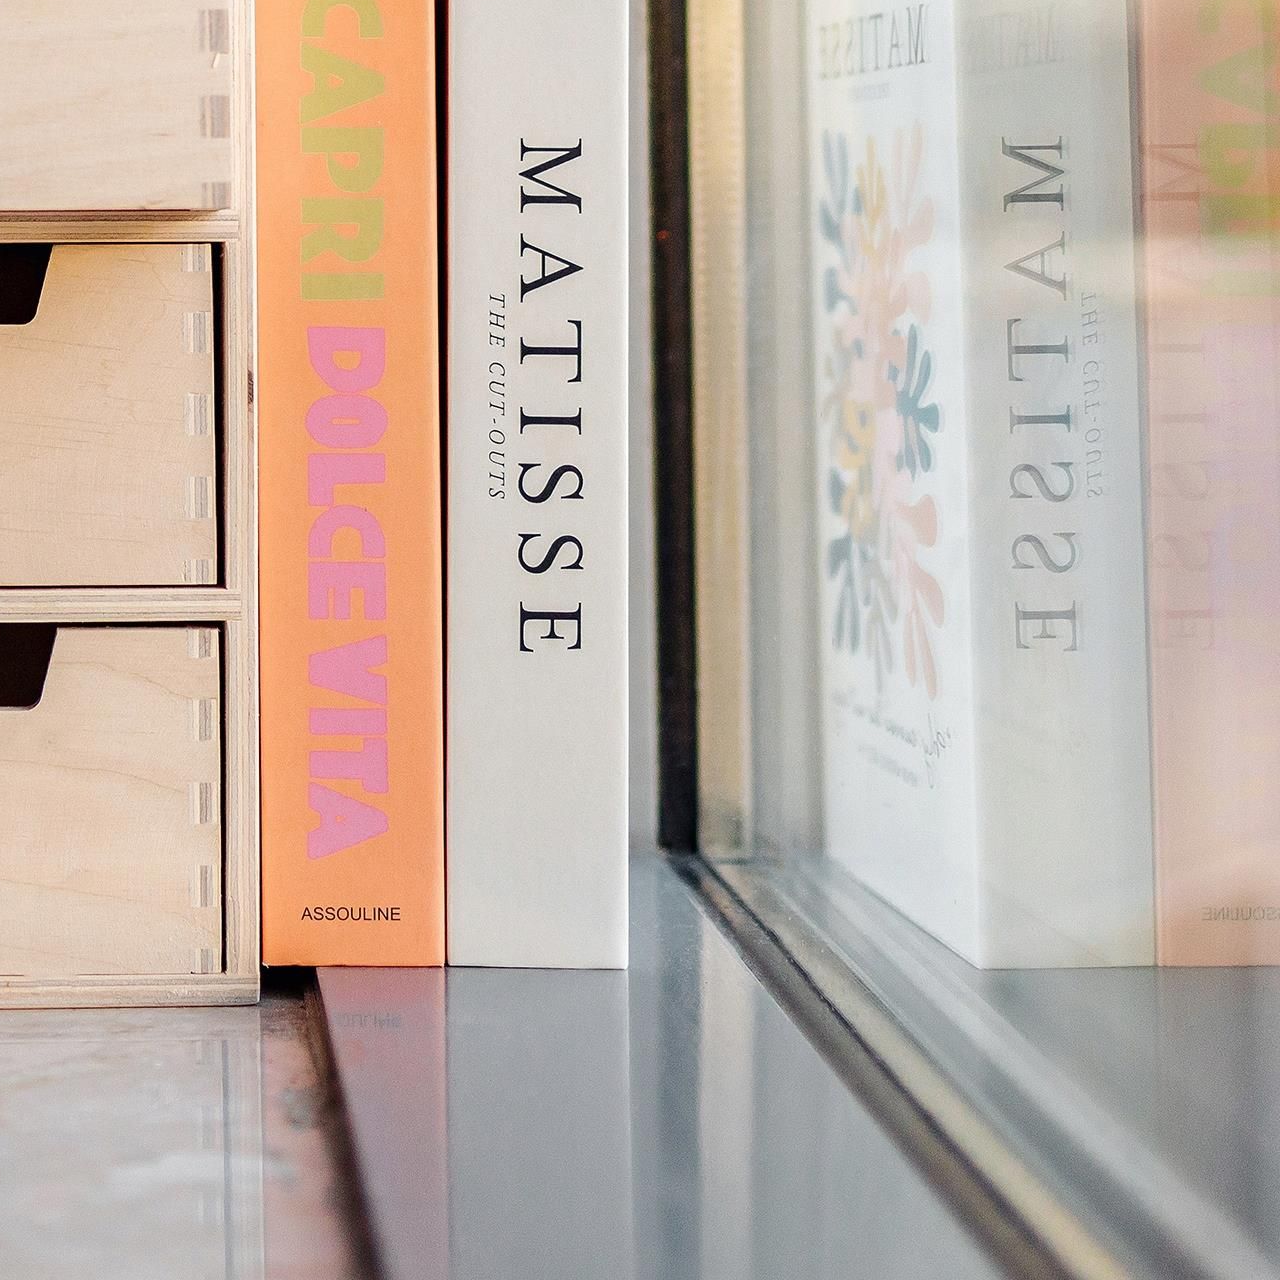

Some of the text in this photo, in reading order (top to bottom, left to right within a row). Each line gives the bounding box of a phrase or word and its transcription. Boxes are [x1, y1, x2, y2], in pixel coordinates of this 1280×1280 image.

[306, 326, 388, 620] DOLCE
[488, 294, 506, 500] THE CUT-OUTS
[519, 138, 584, 653] MATISSE
[307, 634, 389, 860] VITA
[301, 906, 401, 922] ASSOULINE
